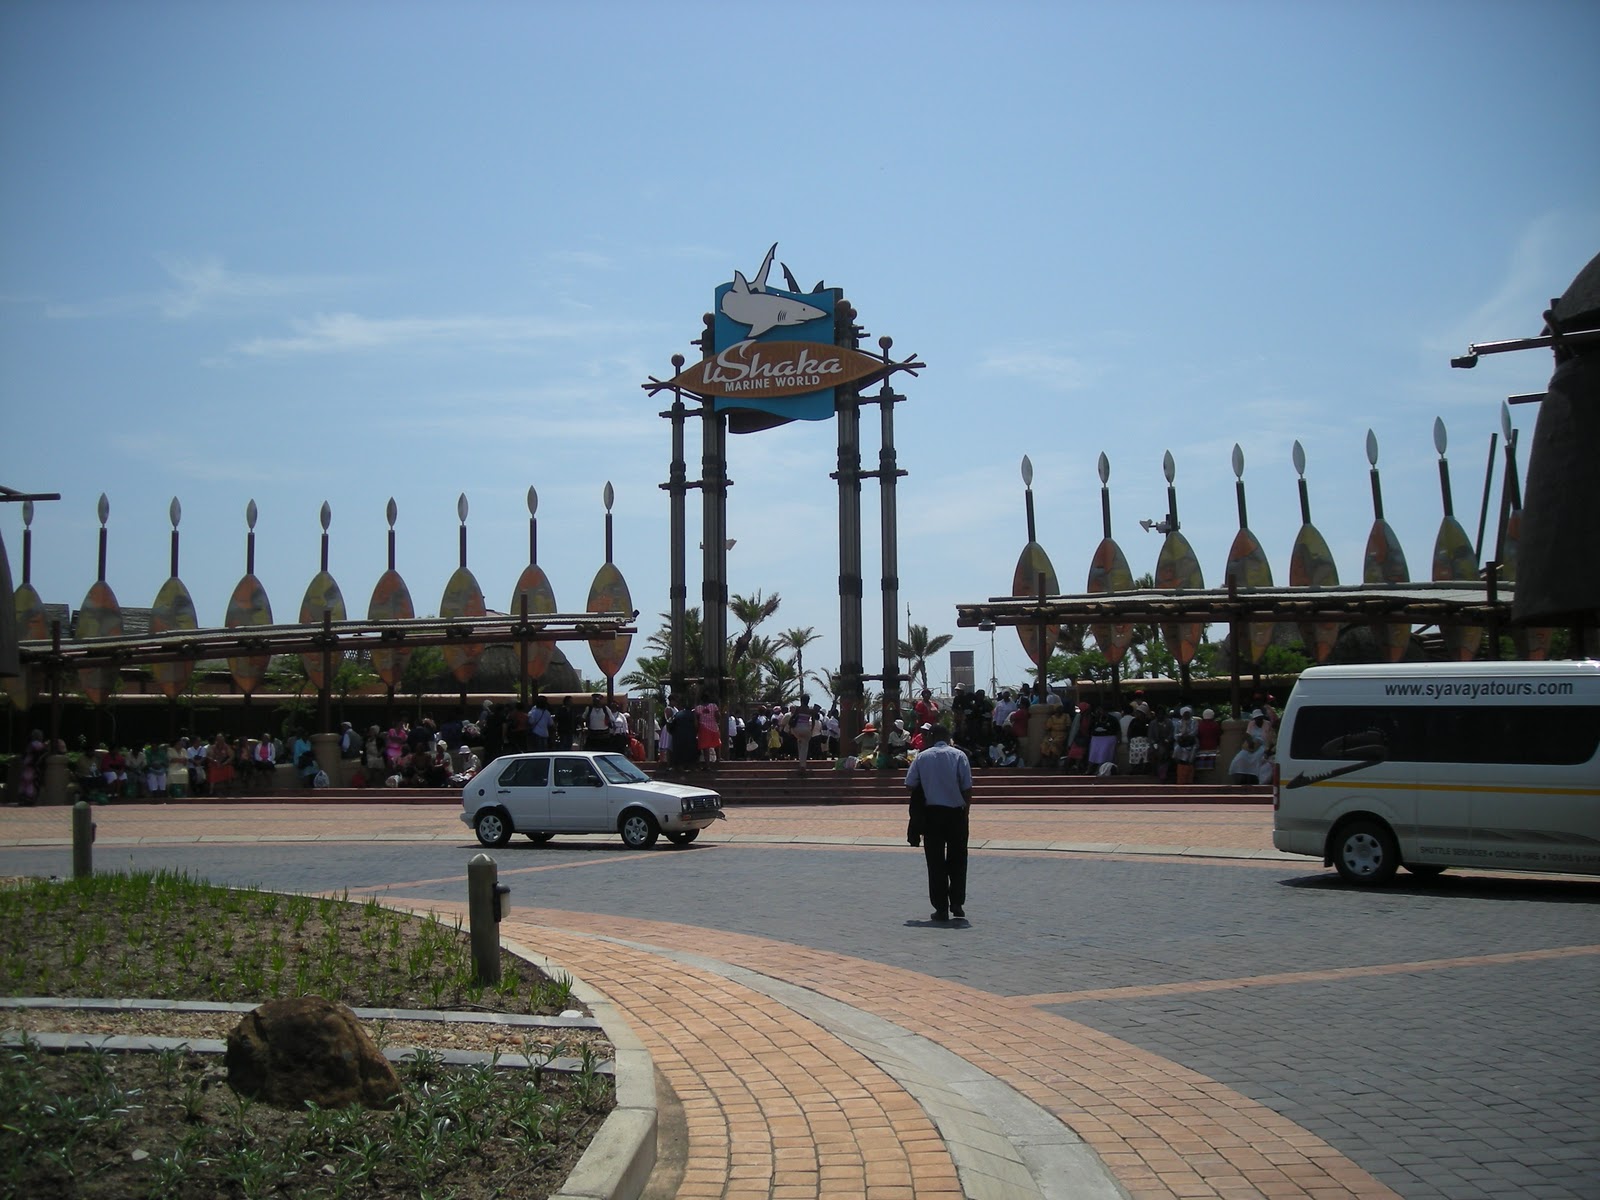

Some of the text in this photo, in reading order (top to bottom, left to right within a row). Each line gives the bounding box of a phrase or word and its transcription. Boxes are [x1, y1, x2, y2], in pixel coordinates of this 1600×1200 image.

[702, 339, 843, 384] uShaka
[725, 375, 820, 392] MARINE WORLD
[1385, 681, 1574, 699] www.syavayatours.com
[1420, 846, 1451, 855] SHUTTLE
[1453, 848, 1488, 857] SERVICES
